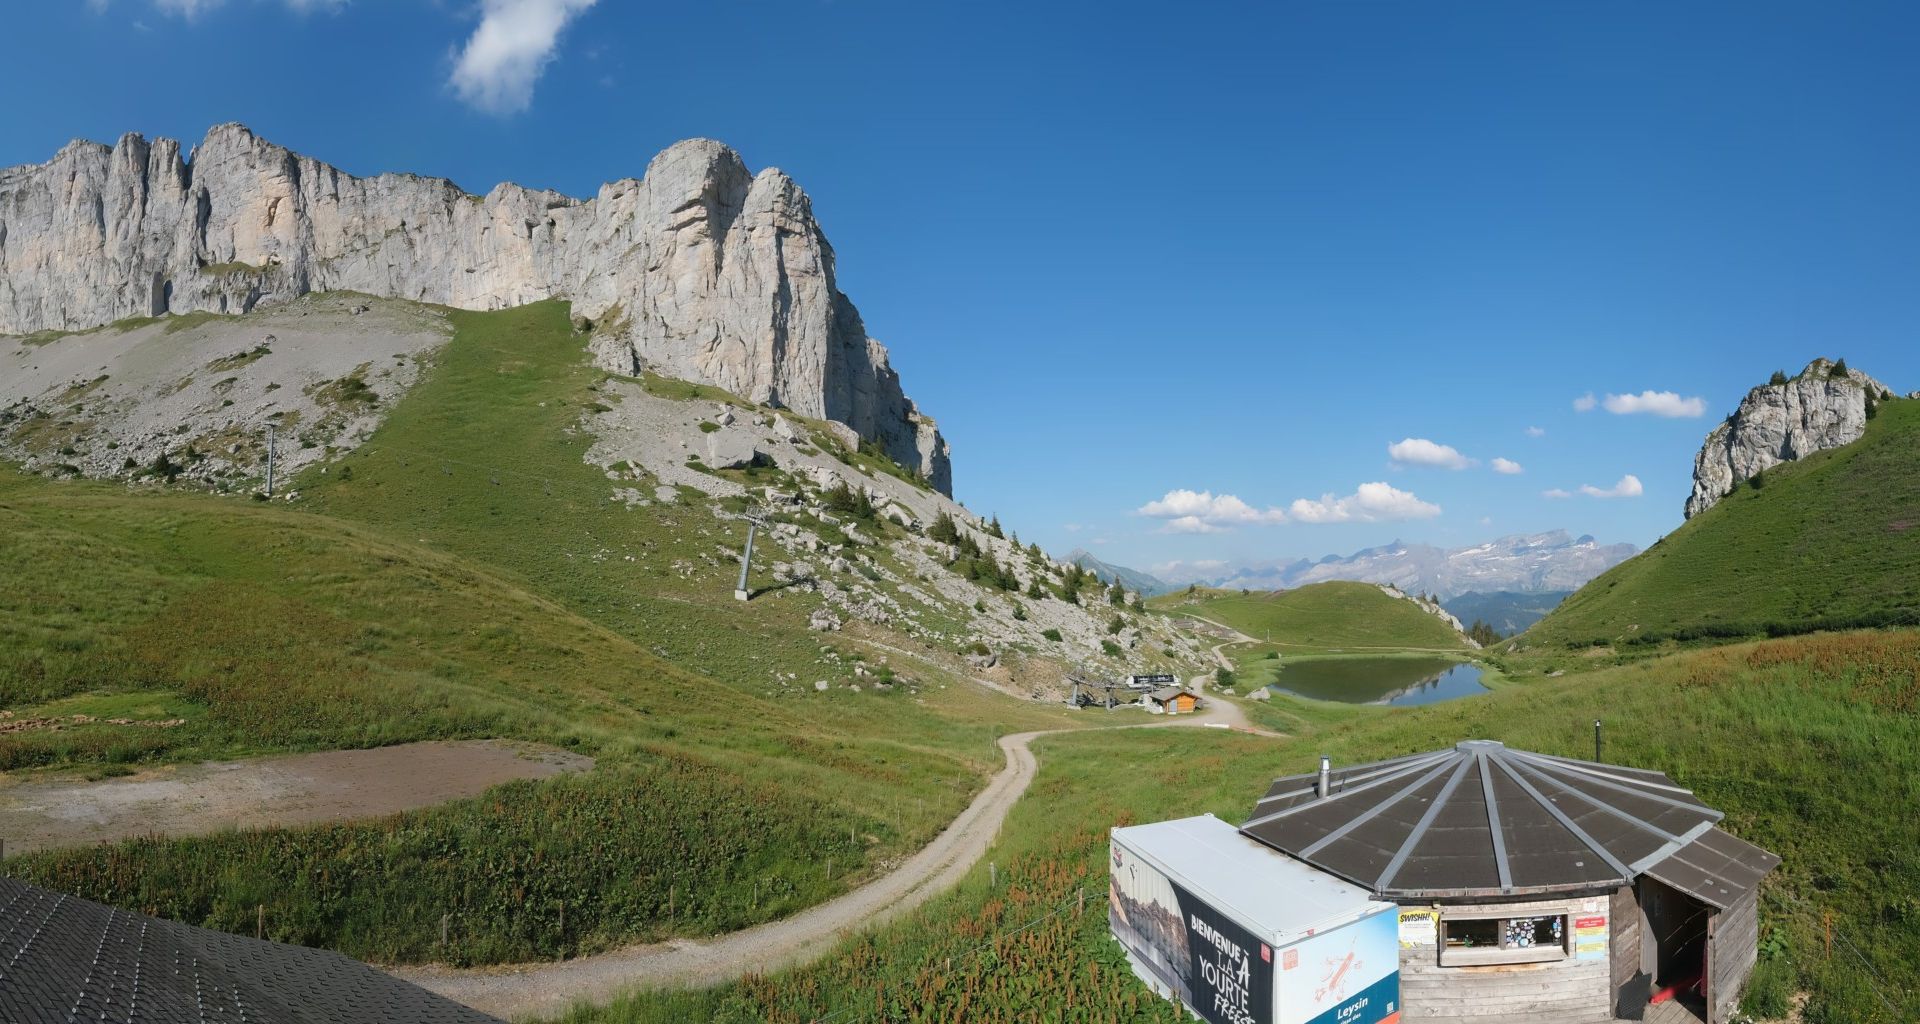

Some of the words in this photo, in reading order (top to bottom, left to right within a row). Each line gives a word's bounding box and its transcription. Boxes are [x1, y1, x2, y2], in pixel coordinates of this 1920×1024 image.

[1400, 912, 1430, 922] SWISHH!
[1191, 914, 1241, 963] BIENVENUE
[1236, 949, 1250, 989] À
[1217, 950, 1236, 980] LA
[1199, 954, 1249, 1015] YOURTE
[1337, 997, 1368, 1020] Leysin
